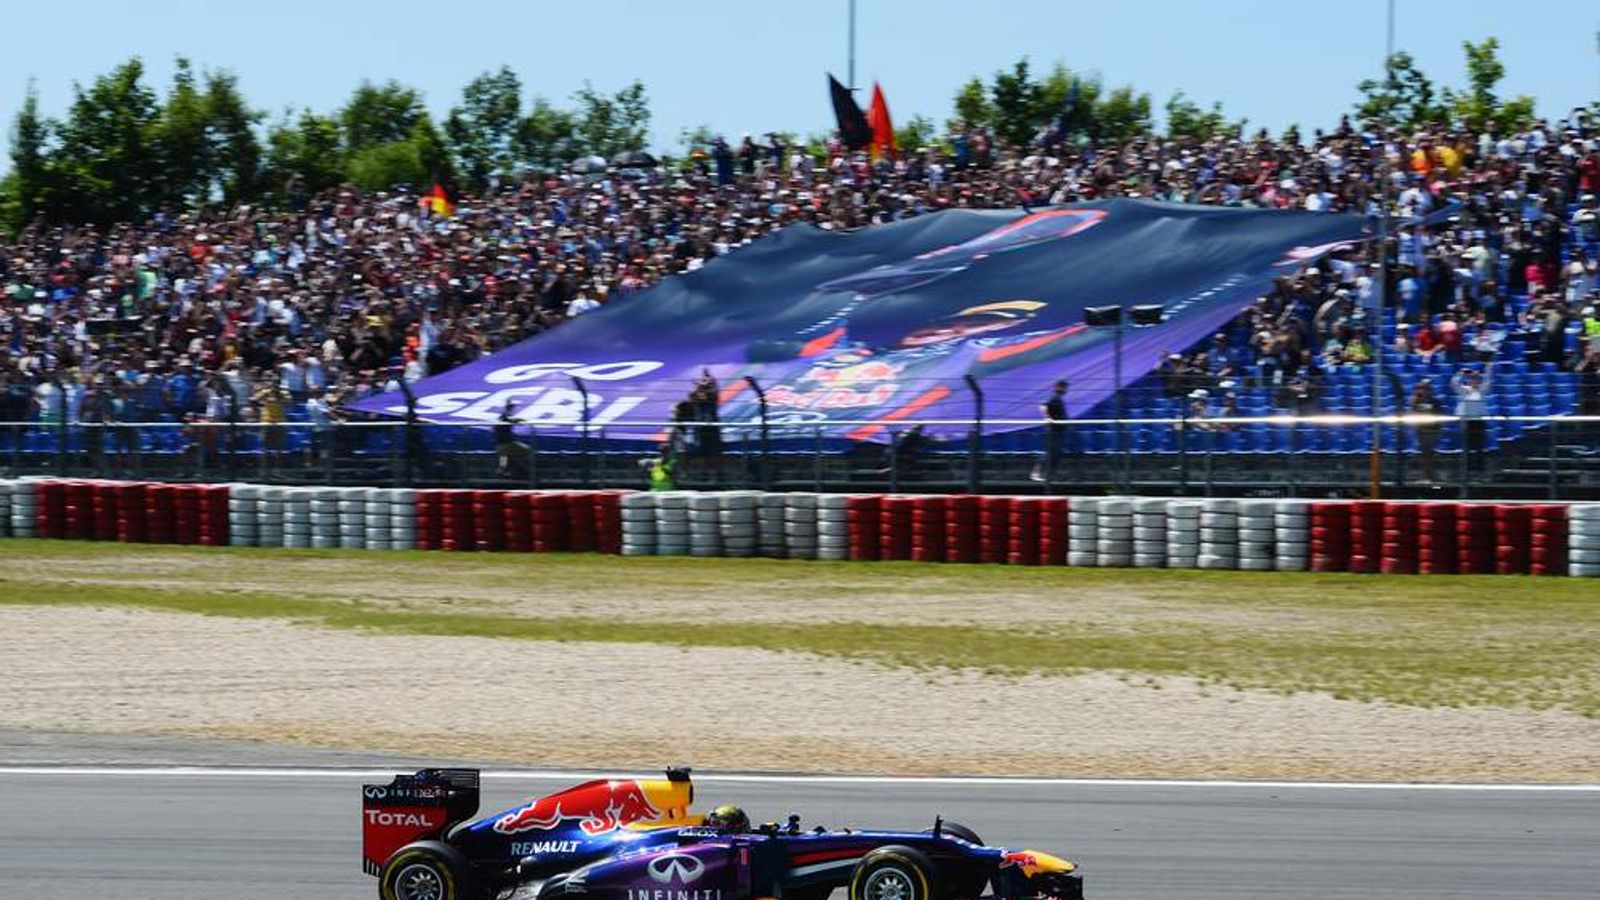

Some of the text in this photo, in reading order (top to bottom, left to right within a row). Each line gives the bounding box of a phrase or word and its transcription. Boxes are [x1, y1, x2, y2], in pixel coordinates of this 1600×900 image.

[484, 361, 664, 384] GO
[384, 387, 647, 431] SEBI
[365, 809, 433, 827] TOTAL
[511, 840, 581, 855] RENAULT
[628, 889, 721, 900] INFINITI
